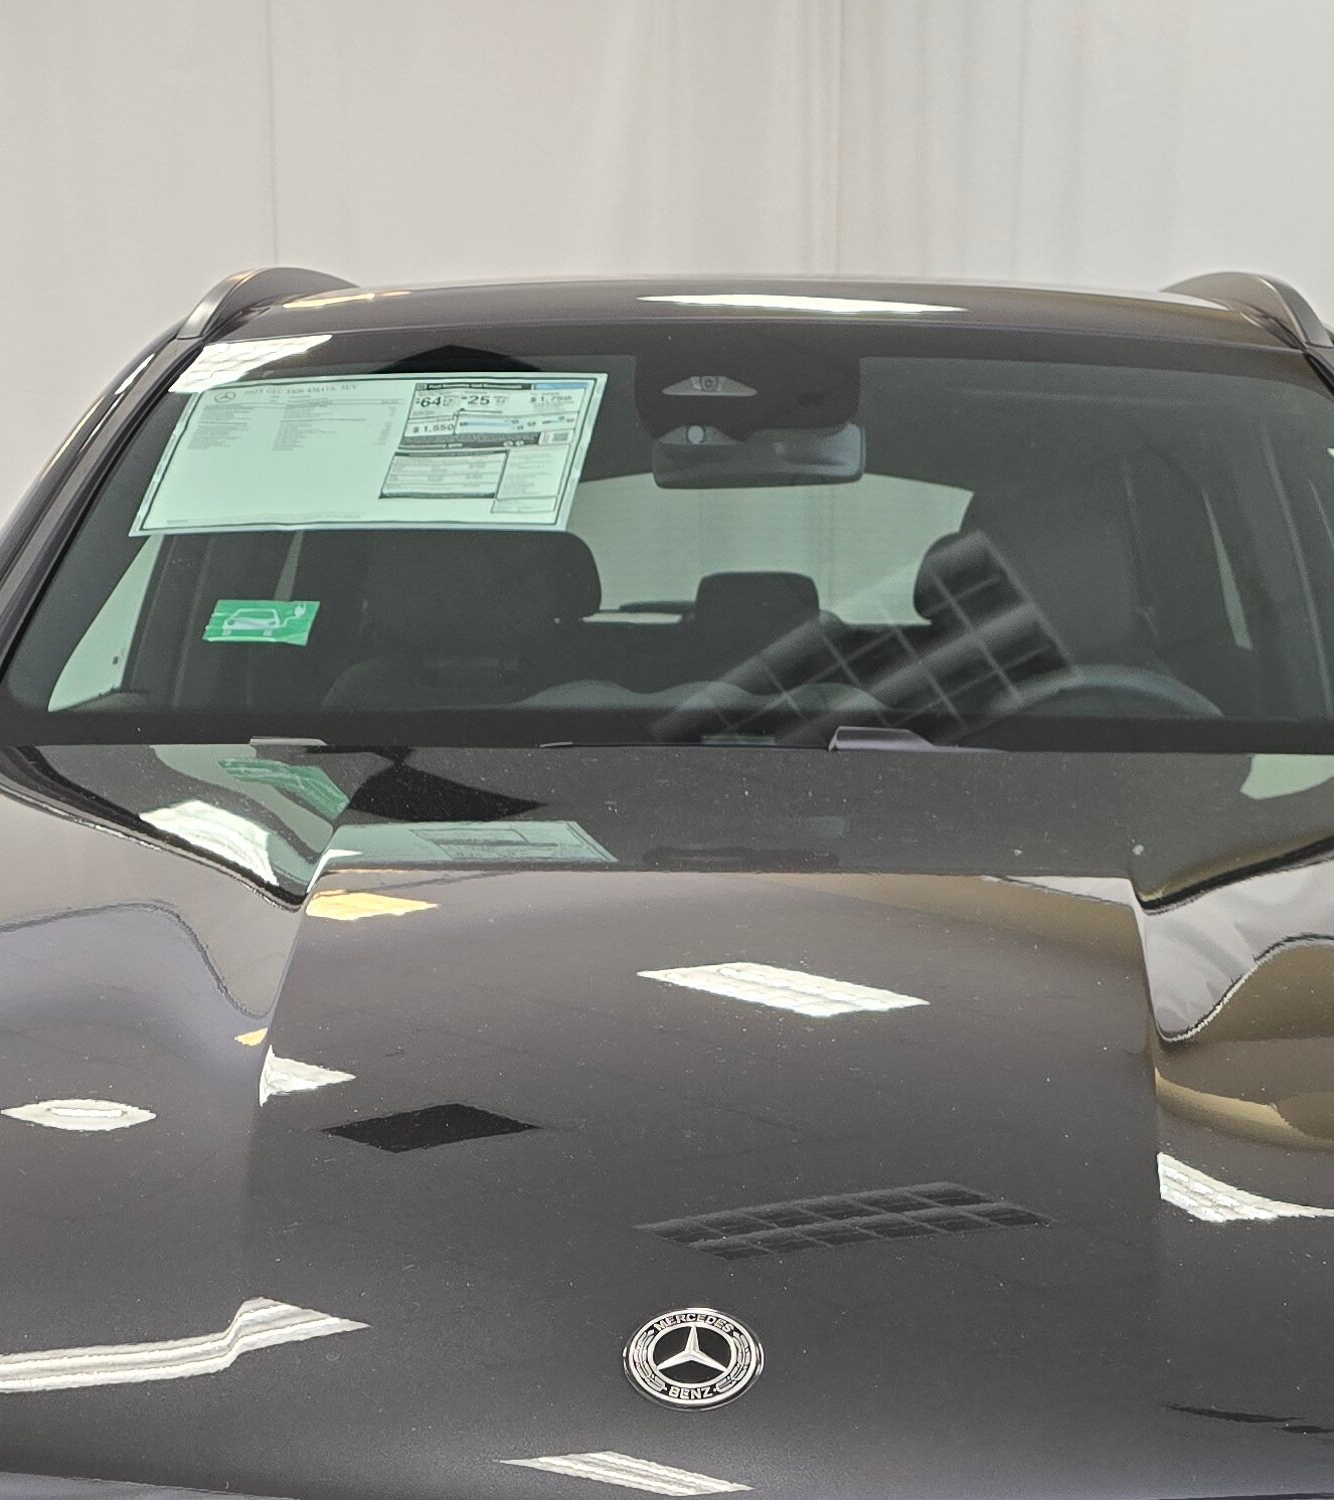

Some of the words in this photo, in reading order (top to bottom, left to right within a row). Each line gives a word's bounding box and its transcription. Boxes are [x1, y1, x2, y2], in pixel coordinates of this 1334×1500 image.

[420, 396, 441, 407] 64
[467, 395, 490, 406] 25
[654, 1313, 734, 1331] MERCEDES
[669, 1386, 713, 1399] BENZ
